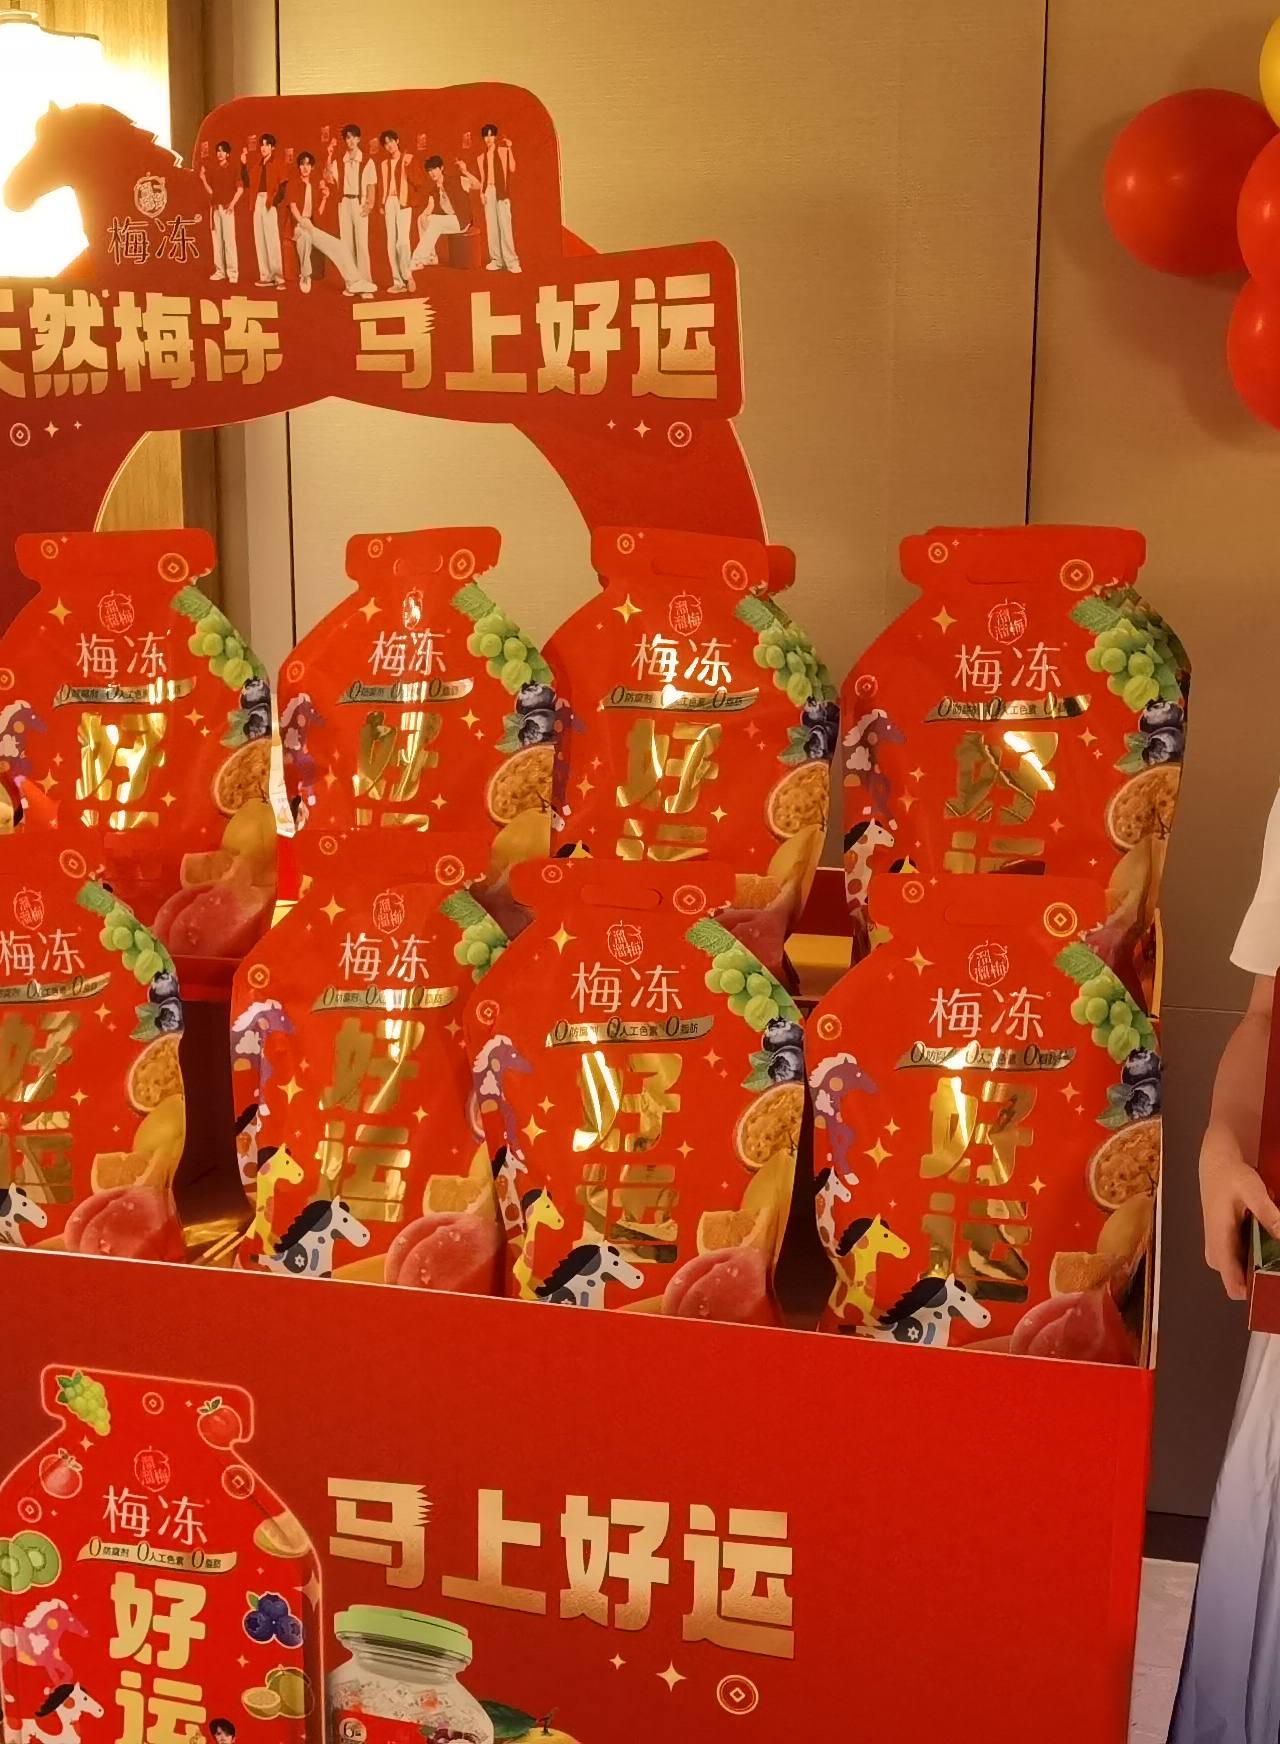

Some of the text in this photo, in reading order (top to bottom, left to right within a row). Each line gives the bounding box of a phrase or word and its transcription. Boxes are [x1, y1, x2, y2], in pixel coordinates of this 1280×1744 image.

[106, 214, 200, 266] 梅冻
[353, 273, 719, 400] 马上好运
[75, 631, 168, 679] 梅冻
[368, 627, 447, 677] 梅冻
[631, 633, 733, 687] 梅冻
[954, 641, 1063, 695] 梅冻
[338, 932, 430, 983] 梅冻
[570, 961, 683, 1014] 梅冻
[928, 987, 1045, 1041] 梅冻
[102, 1484, 208, 1546] 梅冻
[326, 1476, 796, 1660] 马上好运
